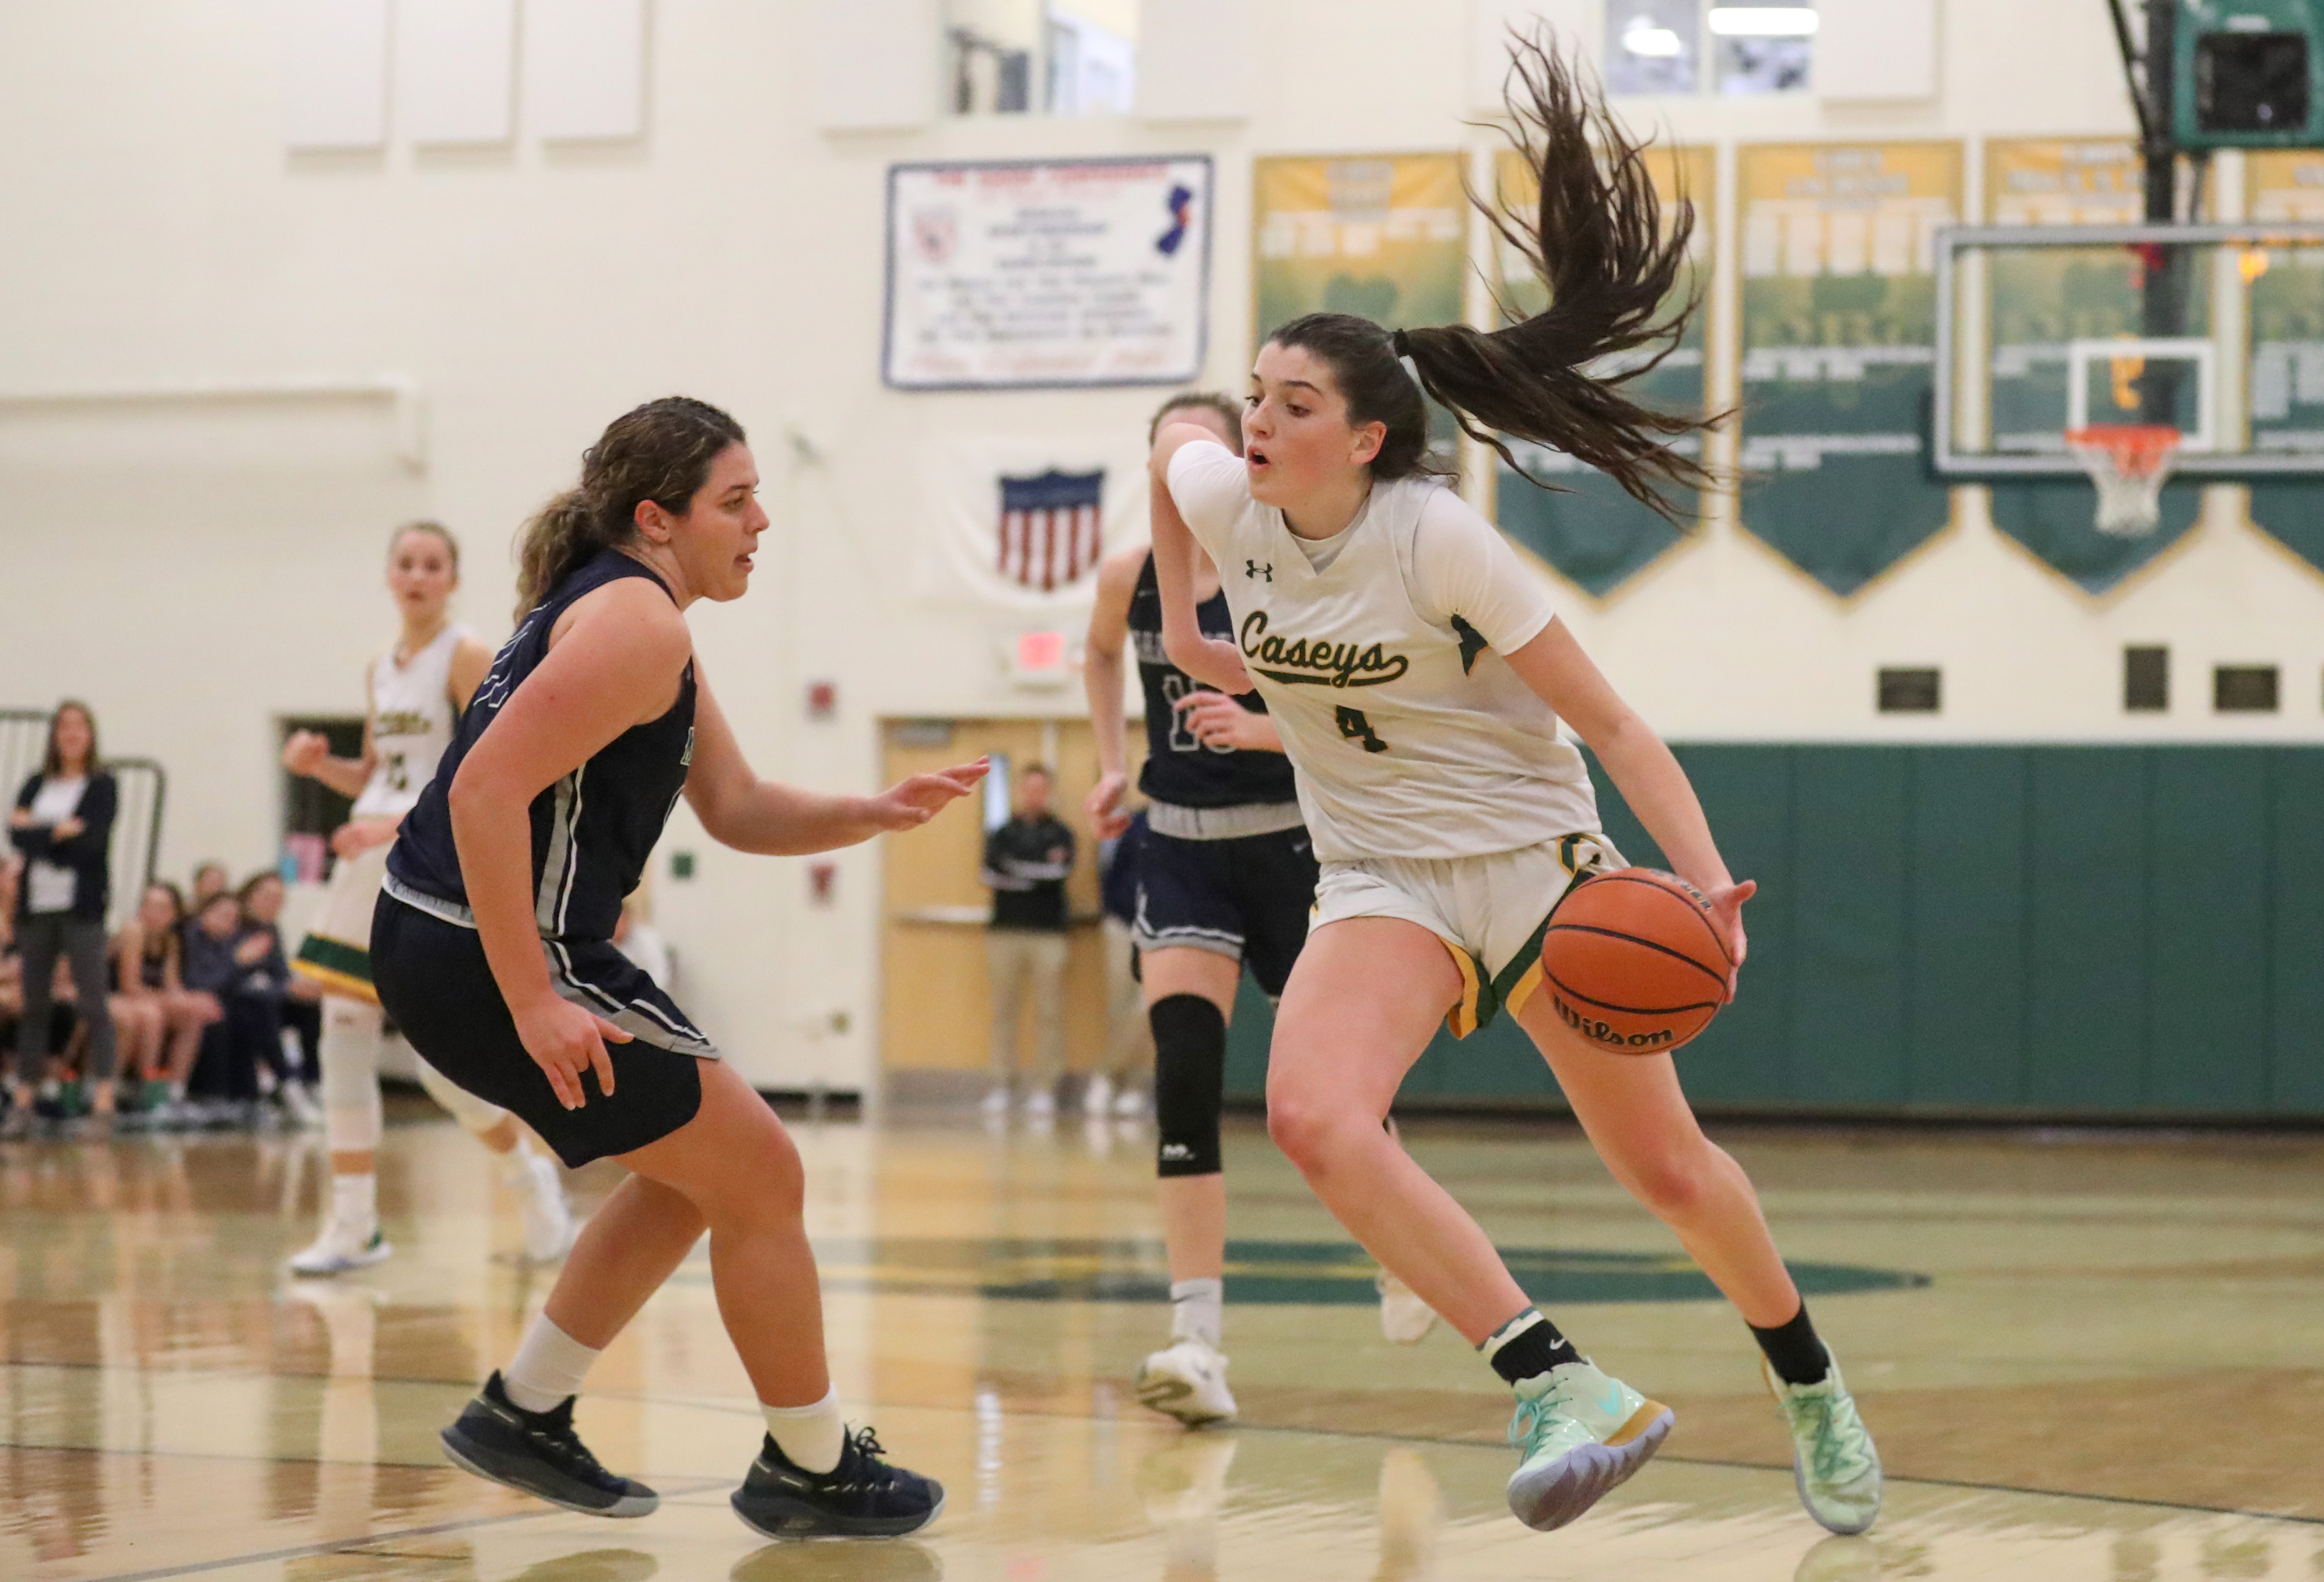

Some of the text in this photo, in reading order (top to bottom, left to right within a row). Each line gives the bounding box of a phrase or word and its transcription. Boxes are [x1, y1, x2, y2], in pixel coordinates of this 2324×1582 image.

[1240, 610, 1408, 689] Caseys
[1334, 704, 1389, 753] 4
[1554, 992, 1674, 1046] Wilson
